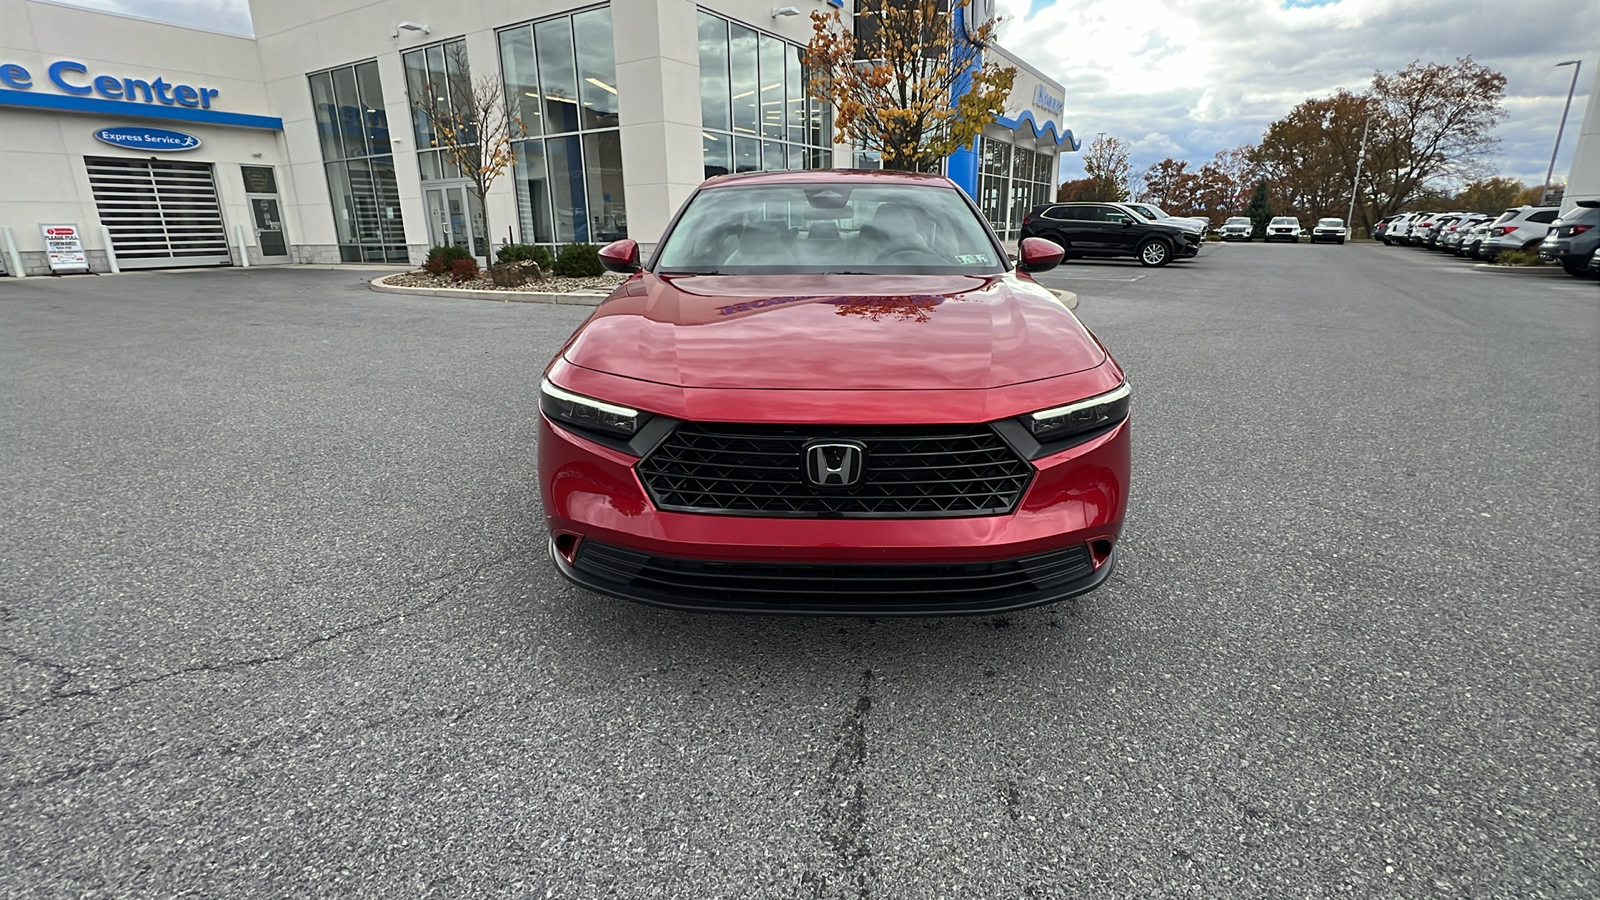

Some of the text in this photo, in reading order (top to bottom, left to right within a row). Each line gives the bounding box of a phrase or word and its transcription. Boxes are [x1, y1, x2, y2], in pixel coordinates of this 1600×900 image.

[48, 60, 219, 109] Center
[102, 131, 181, 145] Express Service
